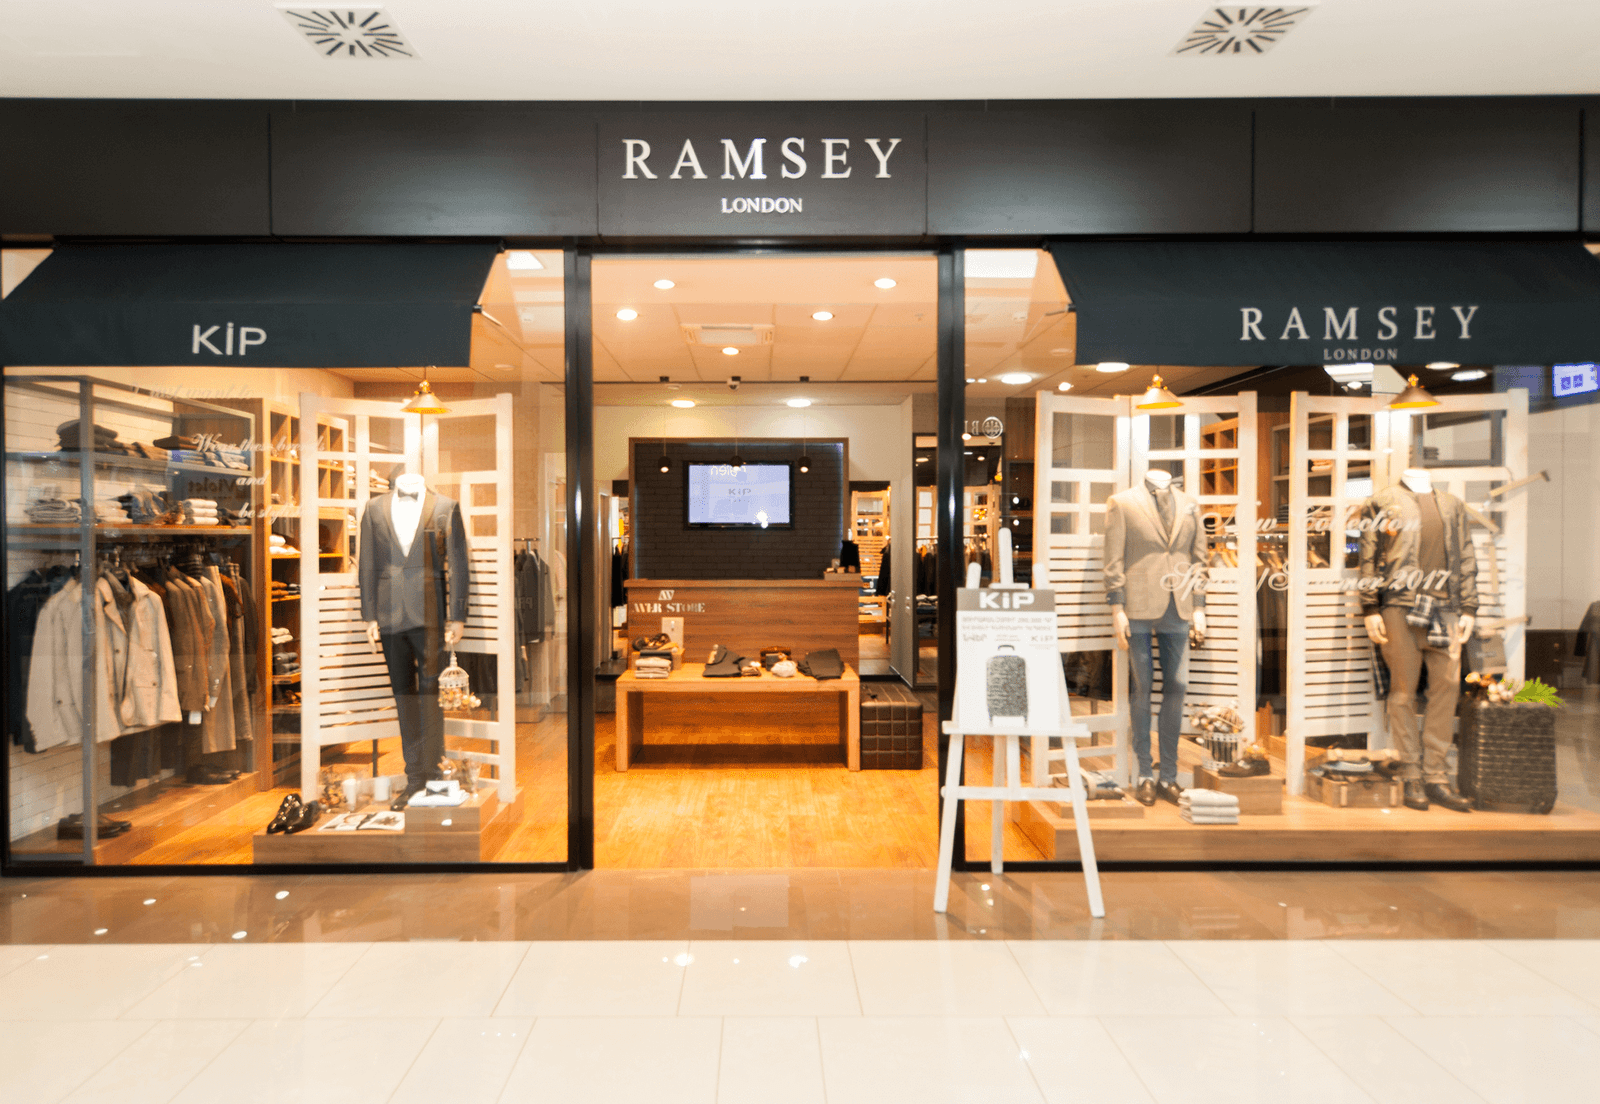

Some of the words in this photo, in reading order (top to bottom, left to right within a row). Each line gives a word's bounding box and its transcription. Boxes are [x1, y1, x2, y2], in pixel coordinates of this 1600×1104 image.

[621, 137, 902, 180] RAMSEY
[721, 197, 803, 214] LONDON
[1239, 305, 1479, 341] RAMSEY
[1323, 348, 1398, 361] LONDON
[276, 436, 325, 452] brads
[236, 471, 269, 486] and
[238, 502, 256, 518] be
[257, 503, 305, 524] stylis
[1200, 503, 1278, 532] Nw
[1389, 569, 1452, 591] 2017
[665, 602, 706, 613] STORE
